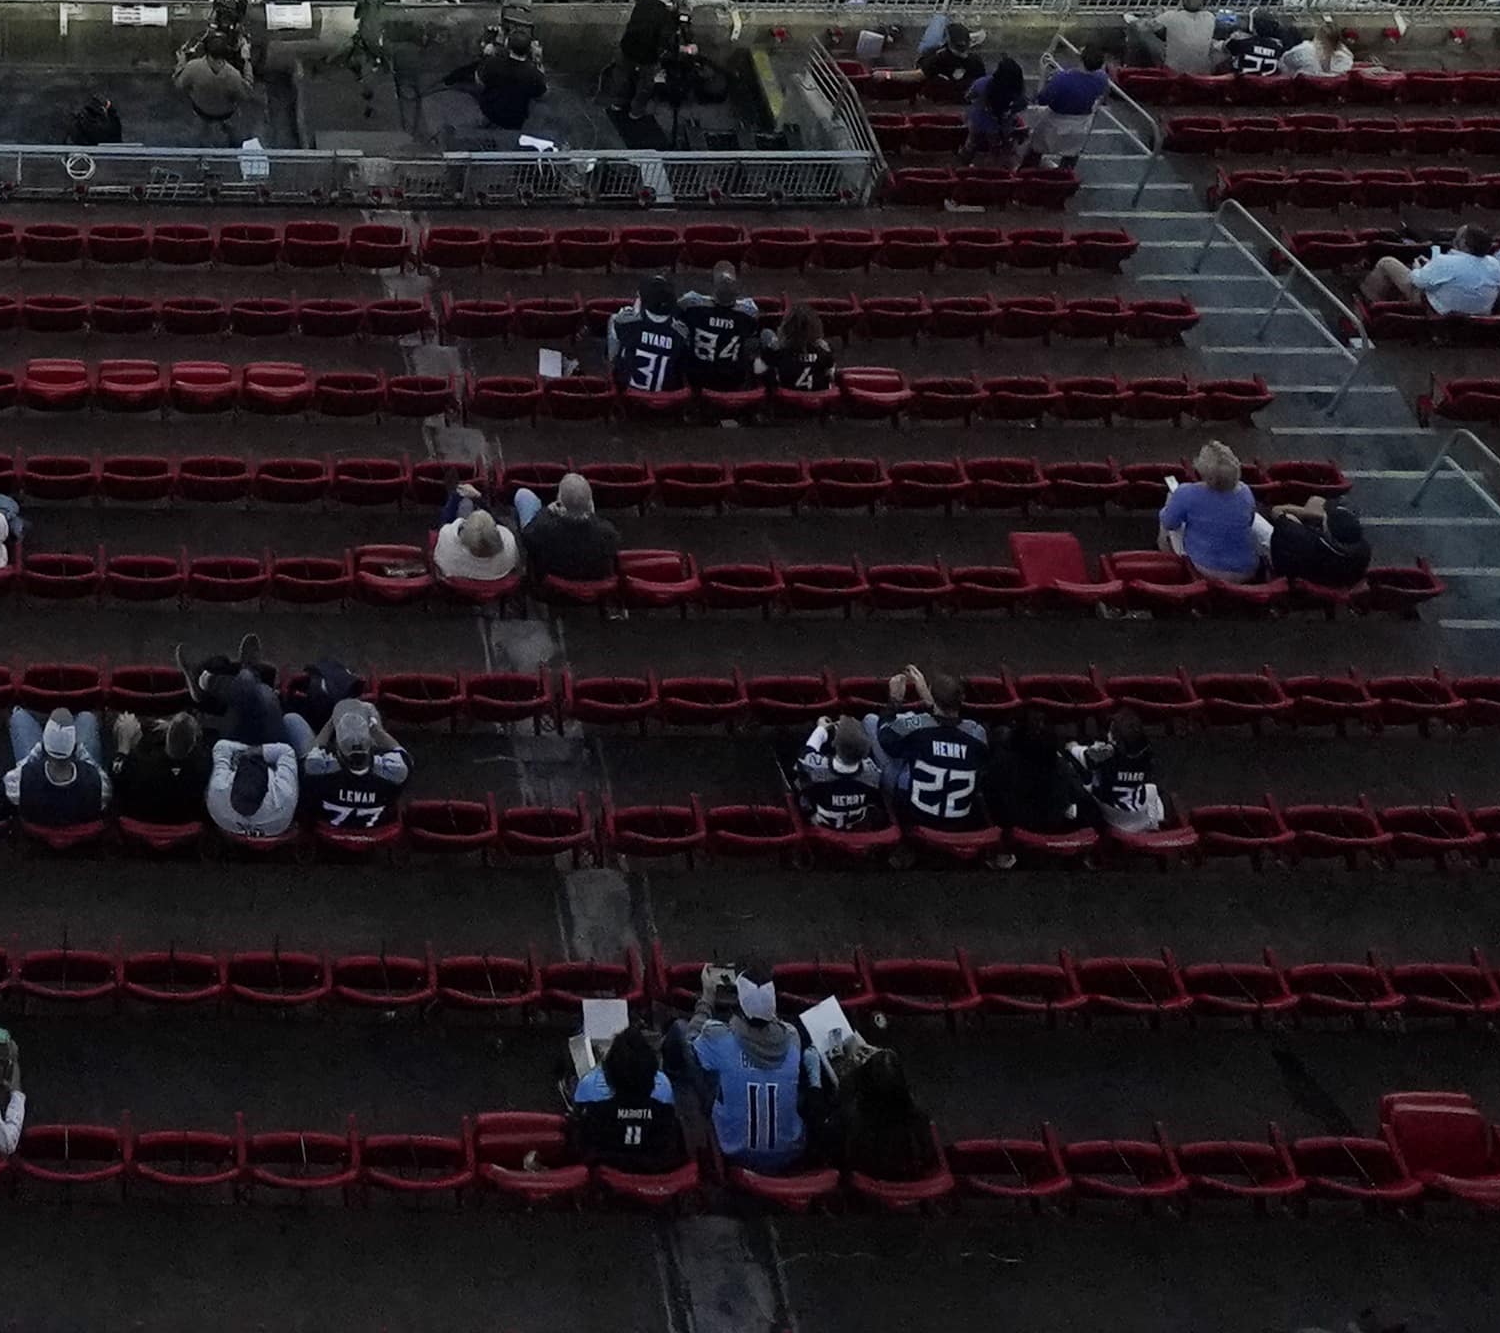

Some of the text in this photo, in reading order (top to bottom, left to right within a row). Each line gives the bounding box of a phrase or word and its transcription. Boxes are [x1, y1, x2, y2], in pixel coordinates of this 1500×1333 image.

[641, 332, 674, 351] BYARD
[629, 348, 671, 393] 31
[932, 739, 969, 761] HENRY
[338, 789, 377, 805] LEWAN
[831, 793, 866, 807] HENRY
[910, 759, 977, 819] 22
[320, 799, 387, 828] 77
[616, 1108, 653, 1120] MARIOTA
[746, 1080, 780, 1151] 11
